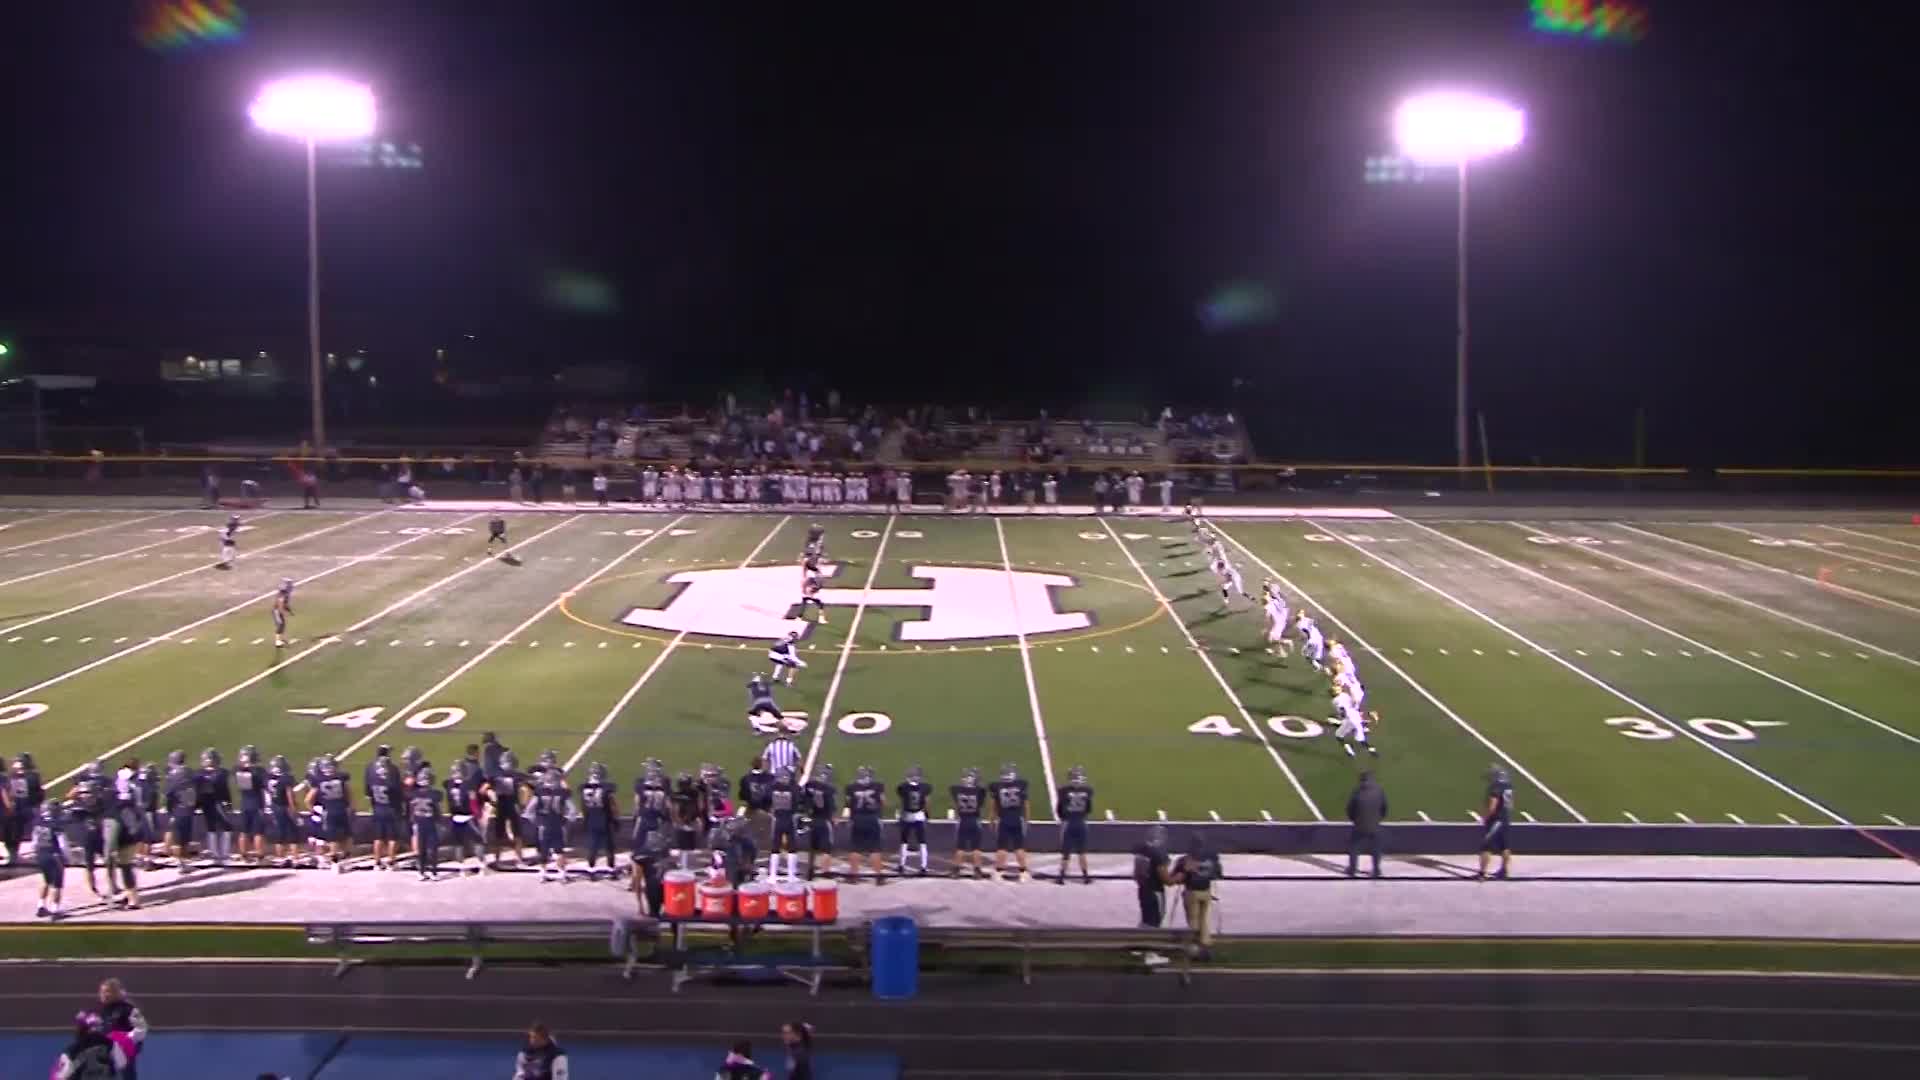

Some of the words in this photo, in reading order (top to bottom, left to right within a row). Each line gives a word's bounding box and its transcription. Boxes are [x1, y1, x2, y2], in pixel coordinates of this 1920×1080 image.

[619, 562, 1095, 642] H
[321, 705, 468, 730] 40
[1187, 714, 1325, 738] 40
[1603, 717, 1757, 741] 30
